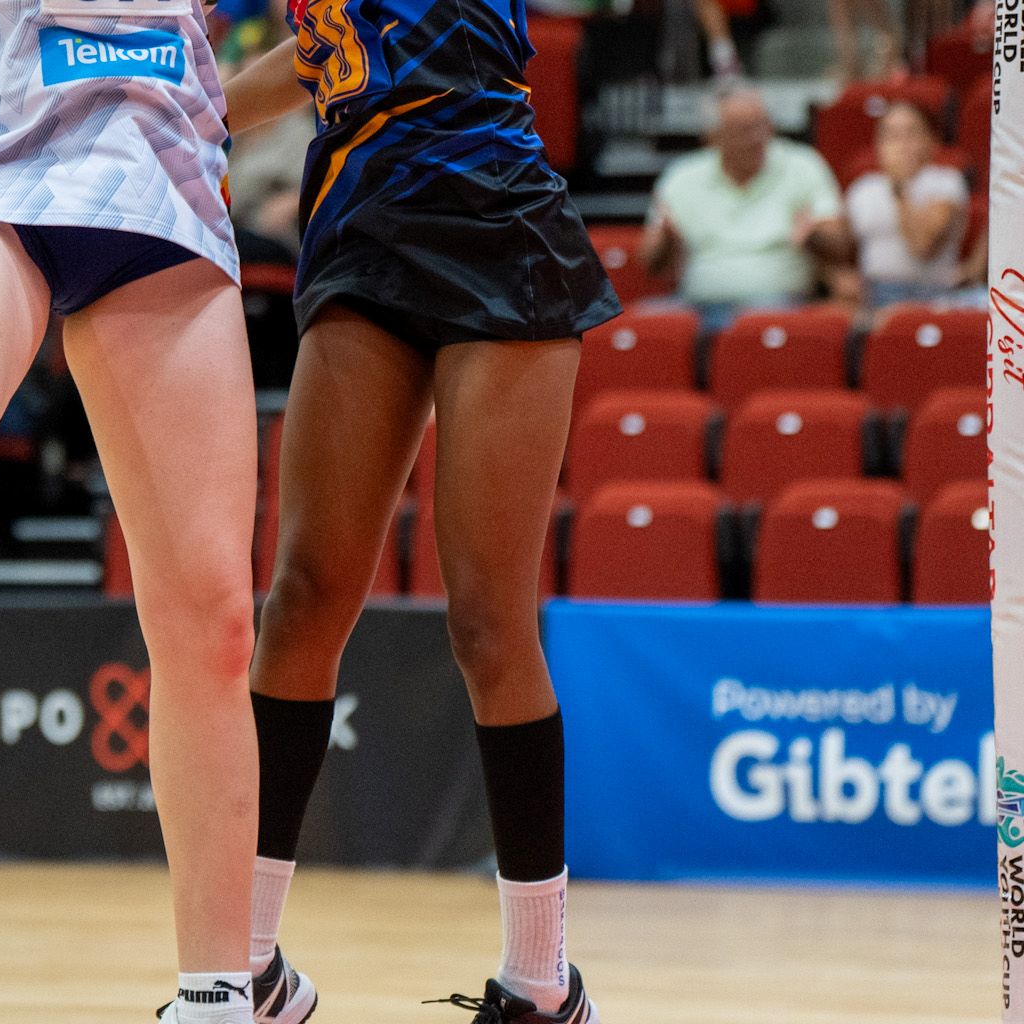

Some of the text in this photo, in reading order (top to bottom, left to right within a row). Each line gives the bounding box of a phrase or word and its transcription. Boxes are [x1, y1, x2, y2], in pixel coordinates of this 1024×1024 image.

[58, 38, 177, 68] Telkom
[993, 61, 1002, 115] CUP
[712, 678, 959, 734] Powered by
[709, 727, 998, 827] Gibtel
[1008, 855, 1024, 958] WORLD
[178, 988, 229, 1004] PUMA
[1002, 955, 1010, 1009] CUP
